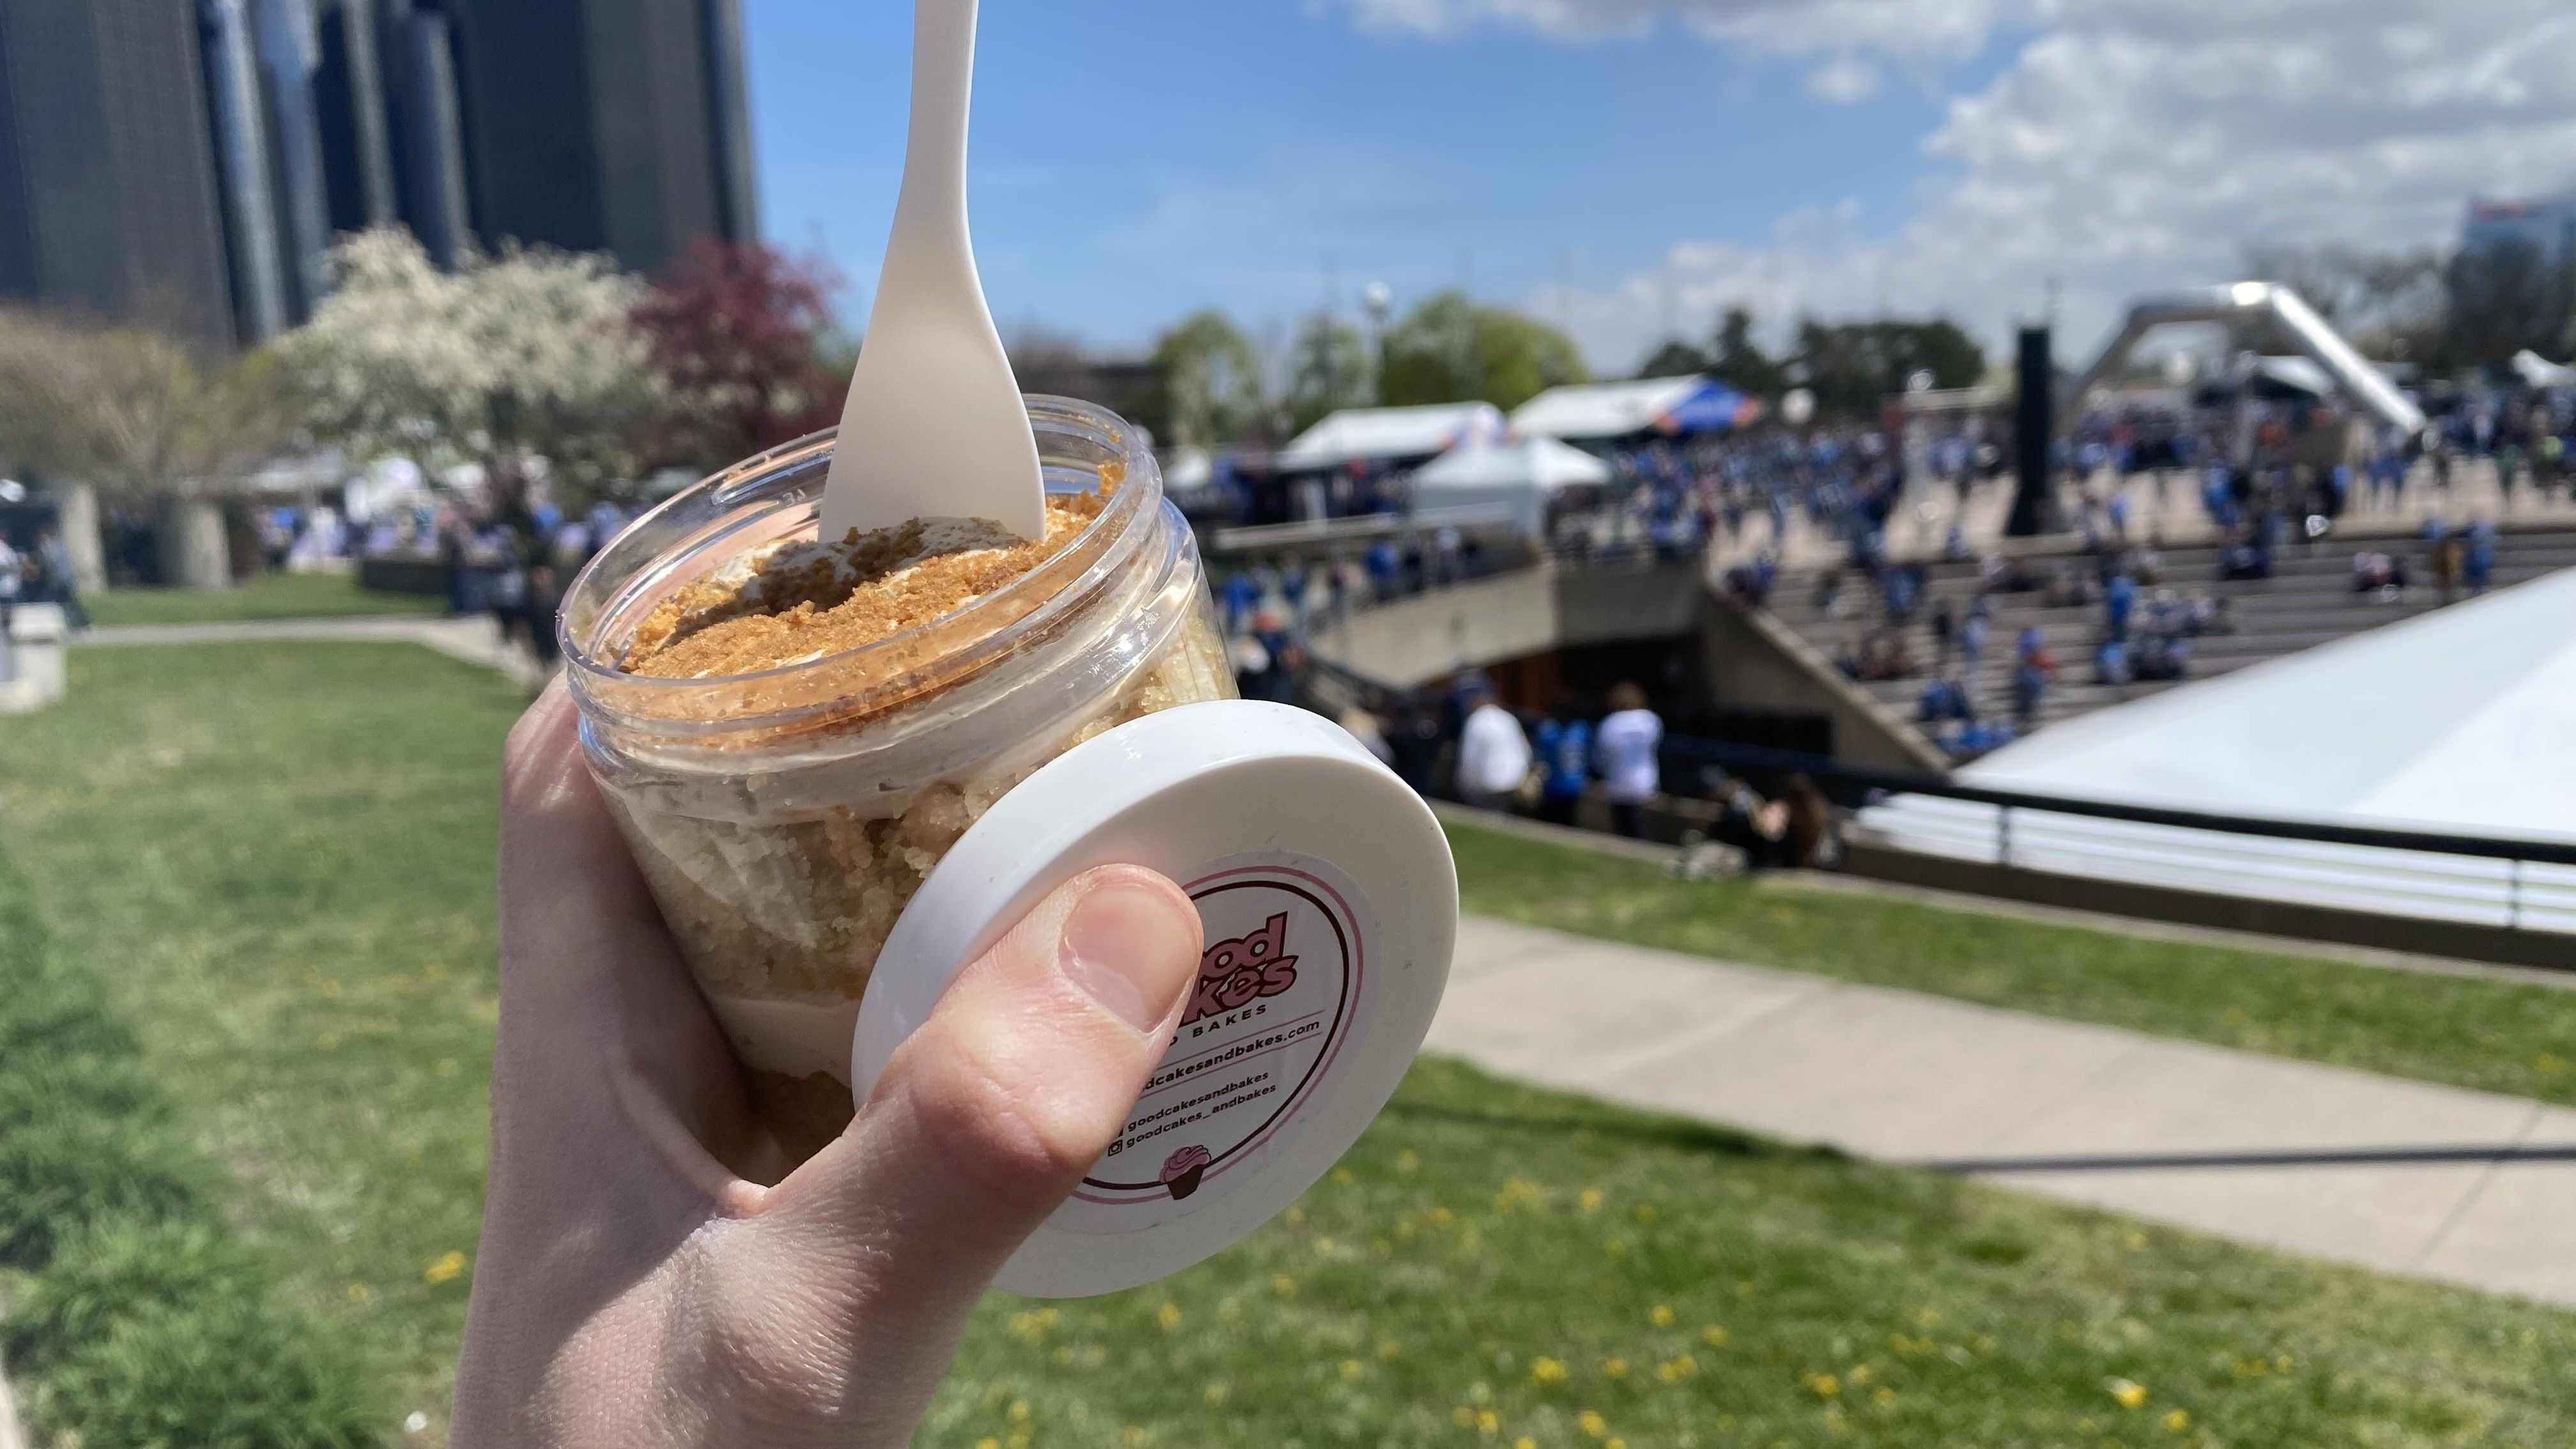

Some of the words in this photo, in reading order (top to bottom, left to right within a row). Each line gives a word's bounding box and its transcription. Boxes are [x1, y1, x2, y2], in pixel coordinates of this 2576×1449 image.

[1199, 911, 1288, 979] od
[1178, 955, 1299, 1028] kes
[1192, 1004, 1267, 1038] BAKES
[1142, 1021, 1319, 1091] dcakesandbakes.com
[1128, 1072, 1269, 1132] goodcakesandbakes
